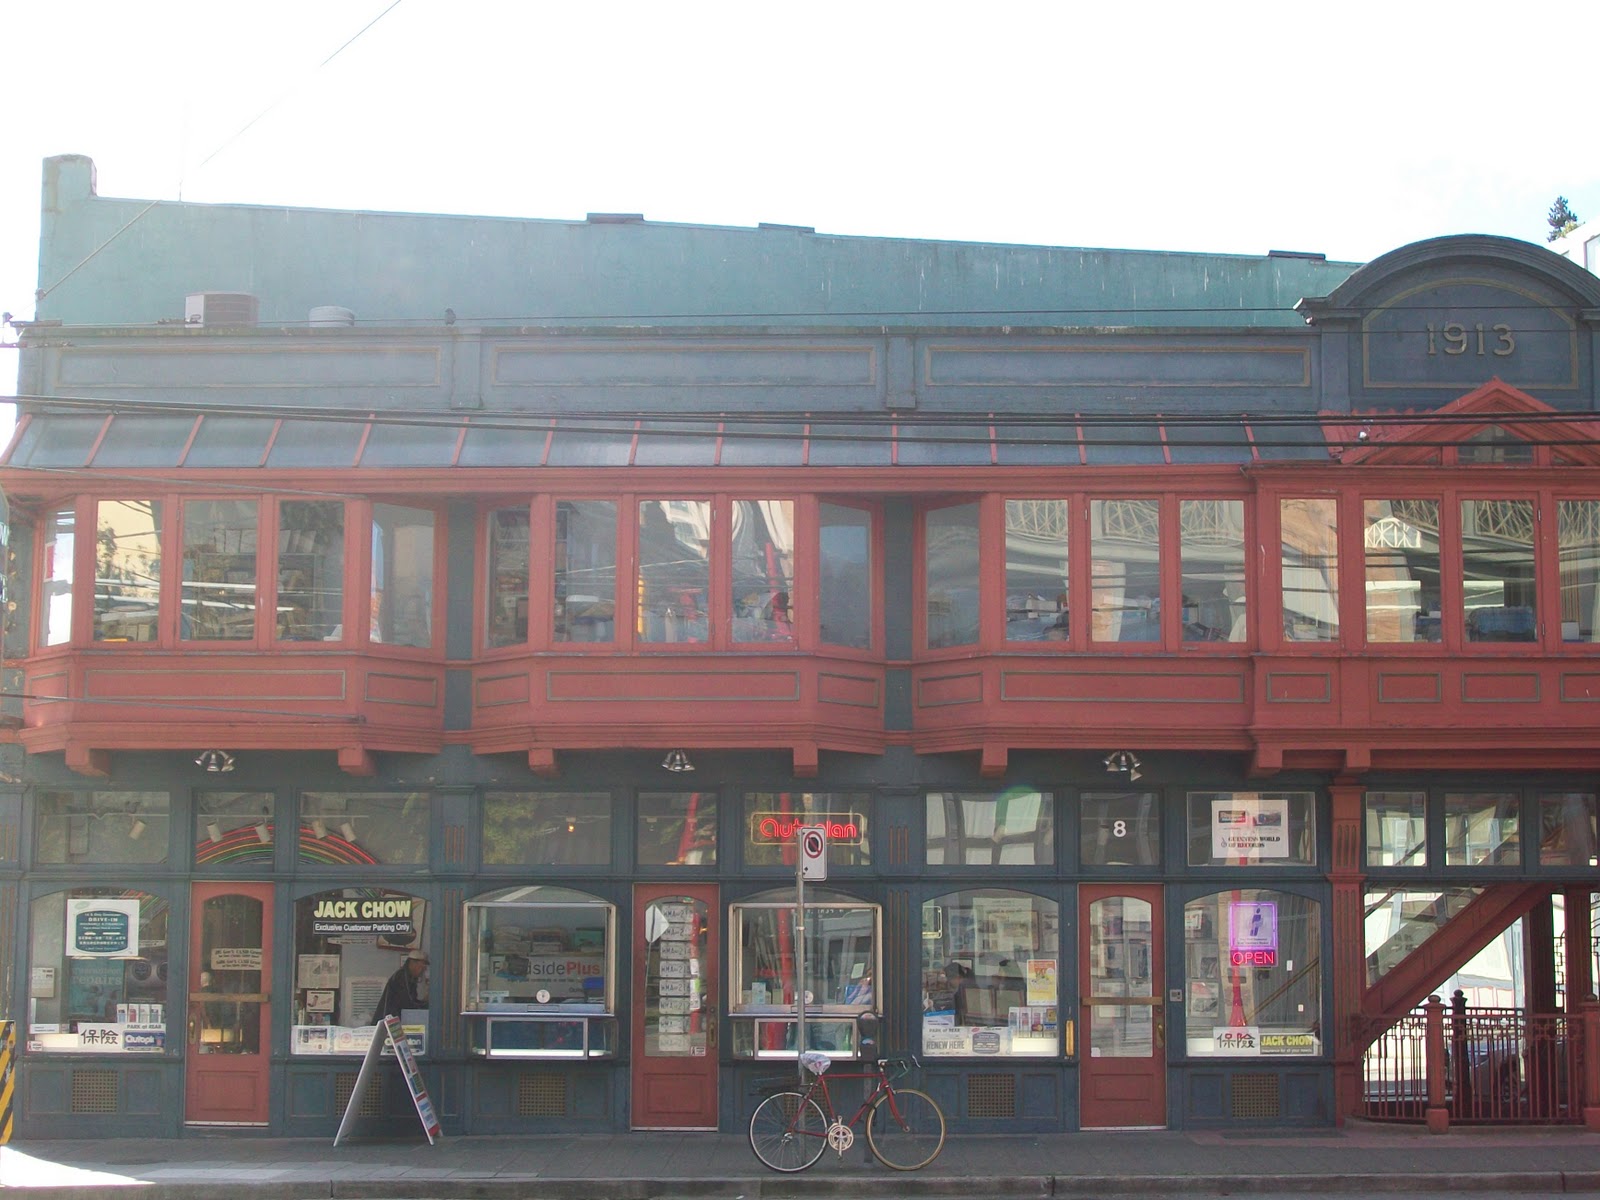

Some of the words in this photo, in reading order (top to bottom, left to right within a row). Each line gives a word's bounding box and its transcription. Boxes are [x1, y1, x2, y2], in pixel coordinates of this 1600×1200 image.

[1426, 322, 1515, 356] 1913
[760, 818, 857, 838] Autlan
[1113, 820, 1127, 838] 8
[313, 900, 358, 918] JACK
[361, 900, 411, 918] CHOW
[315, 923, 343, 931] Exclusive
[343, 923, 372, 932] Customer
[372, 923, 395, 932] Parking
[396, 923, 410, 932] Only
[1232, 951, 1274, 965] OPEN
[492, 960, 601, 976] dsidePlus
[71, 974, 122, 986] repairs
[80, 1029, 119, 1045] 保險
[126, 1034, 158, 1045] Autopl
[926, 1040, 948, 1050] RENEW
[949, 1040, 965, 1049] HERE
[1216, 1032, 1256, 1049] 保險
[1261, 1035, 1285, 1046] JACK
[1286, 1035, 1313, 1046] CHOW
